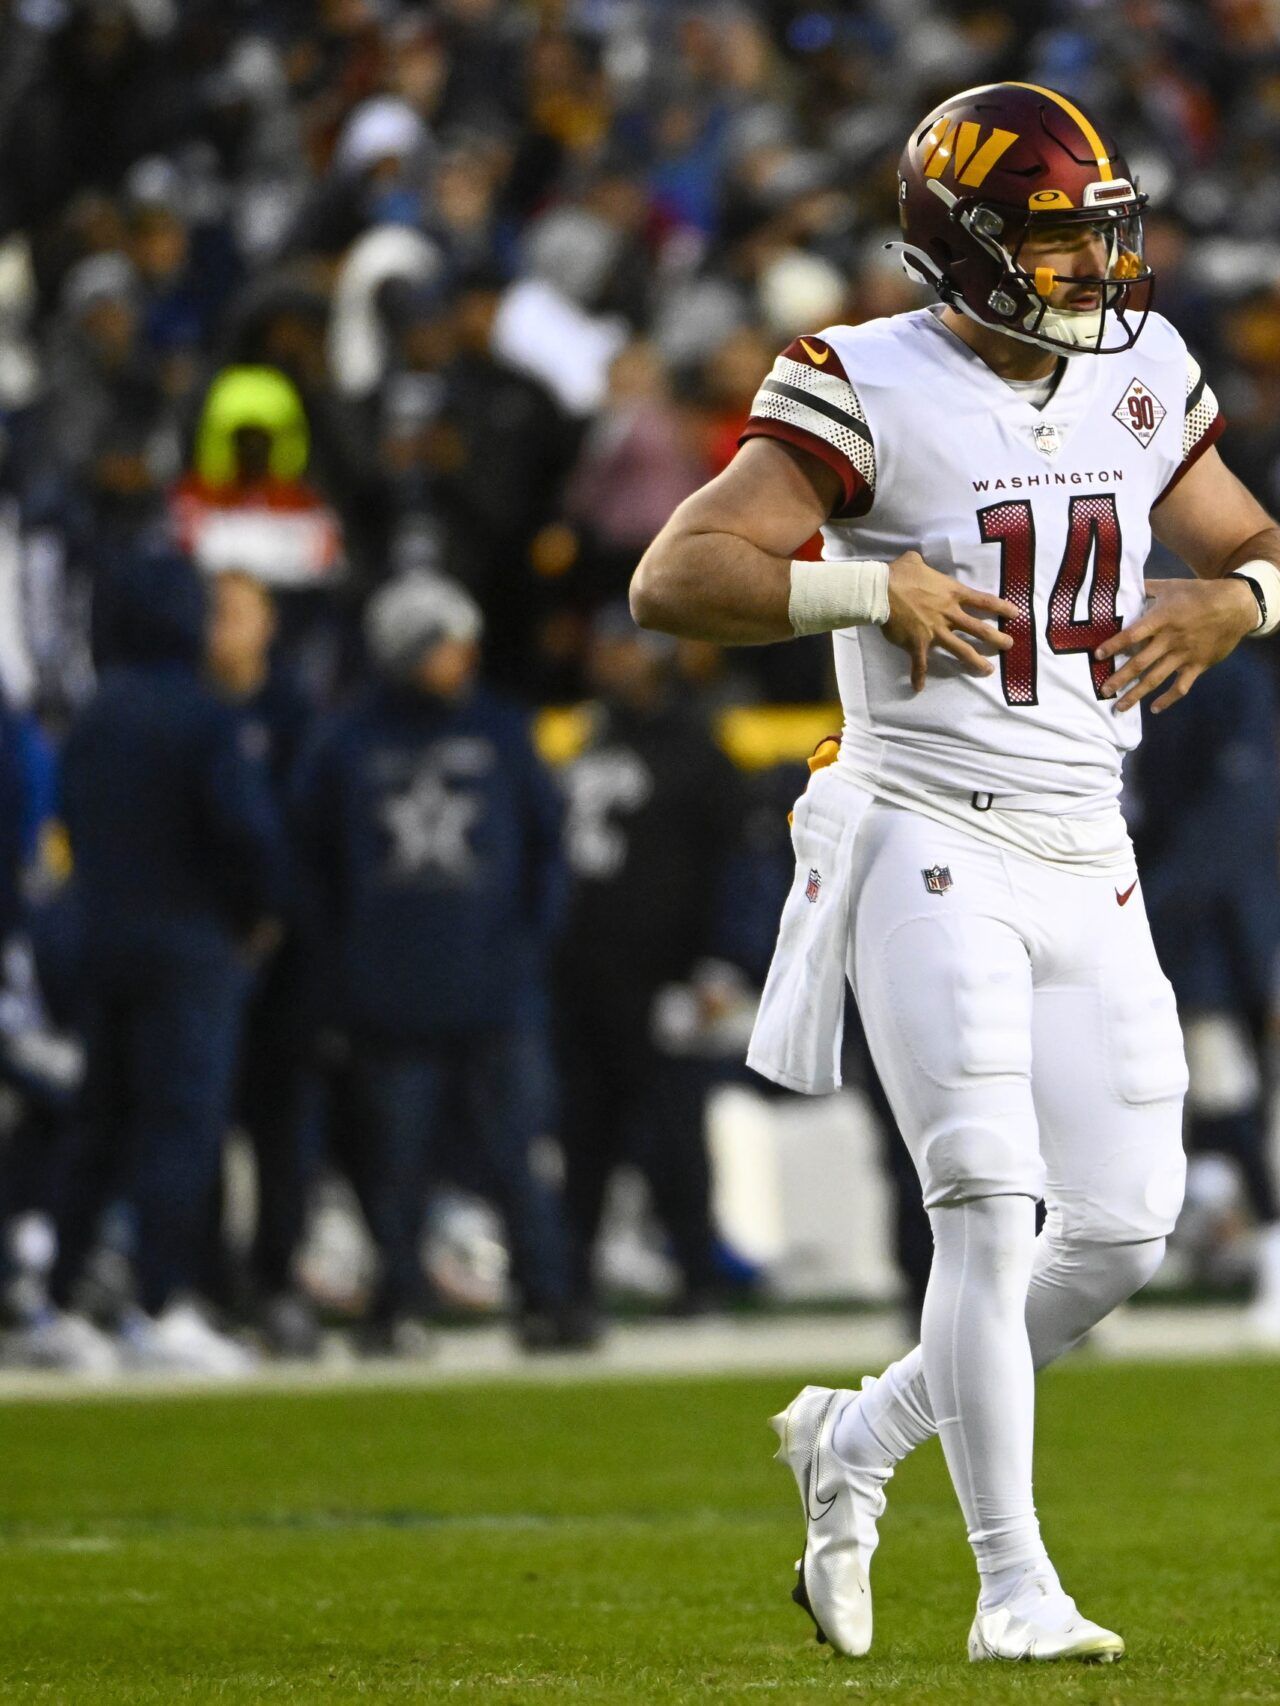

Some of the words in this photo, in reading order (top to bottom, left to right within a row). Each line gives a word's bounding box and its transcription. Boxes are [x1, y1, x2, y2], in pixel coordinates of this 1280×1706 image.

[1127, 395, 1155, 430] 90
[972, 470, 1124, 492] WASHINGTON
[976, 493, 1123, 706] 14
